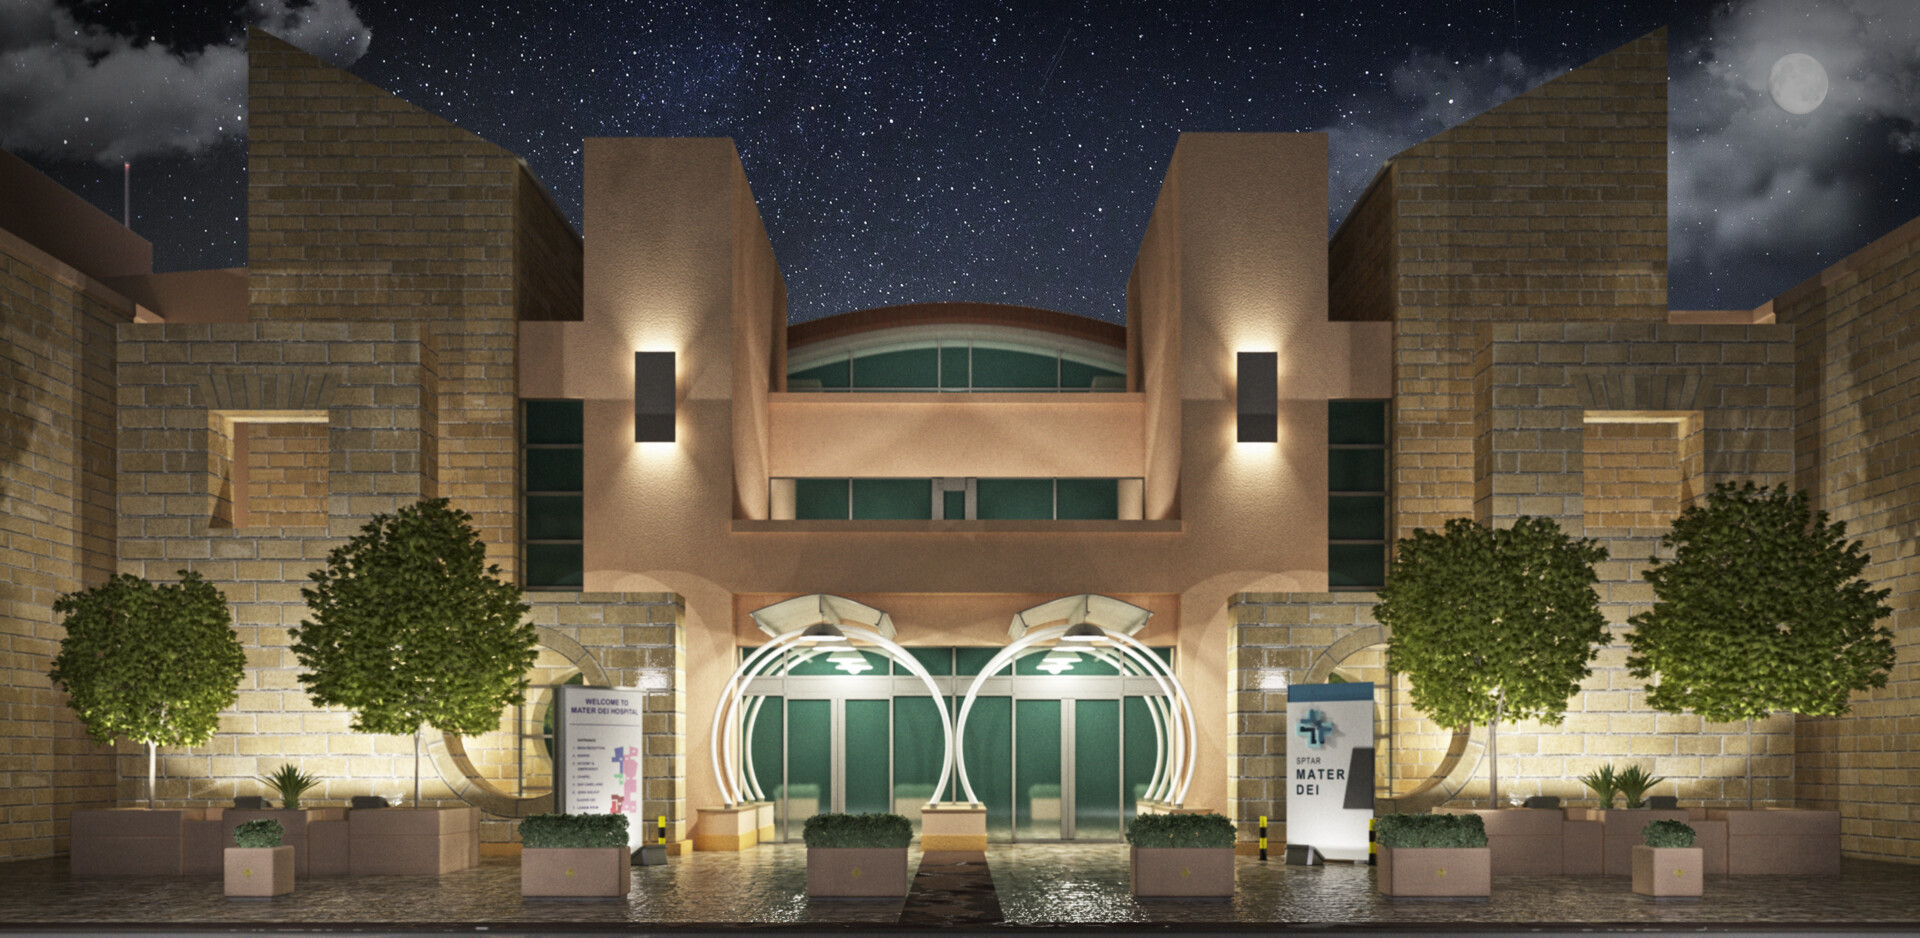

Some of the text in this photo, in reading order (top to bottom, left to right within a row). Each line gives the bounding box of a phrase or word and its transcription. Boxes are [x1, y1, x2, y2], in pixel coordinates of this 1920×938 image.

[585, 698, 619, 706] WELCOME
[1296, 769, 1345, 780] MATER
[1296, 784, 1319, 795] DEI
